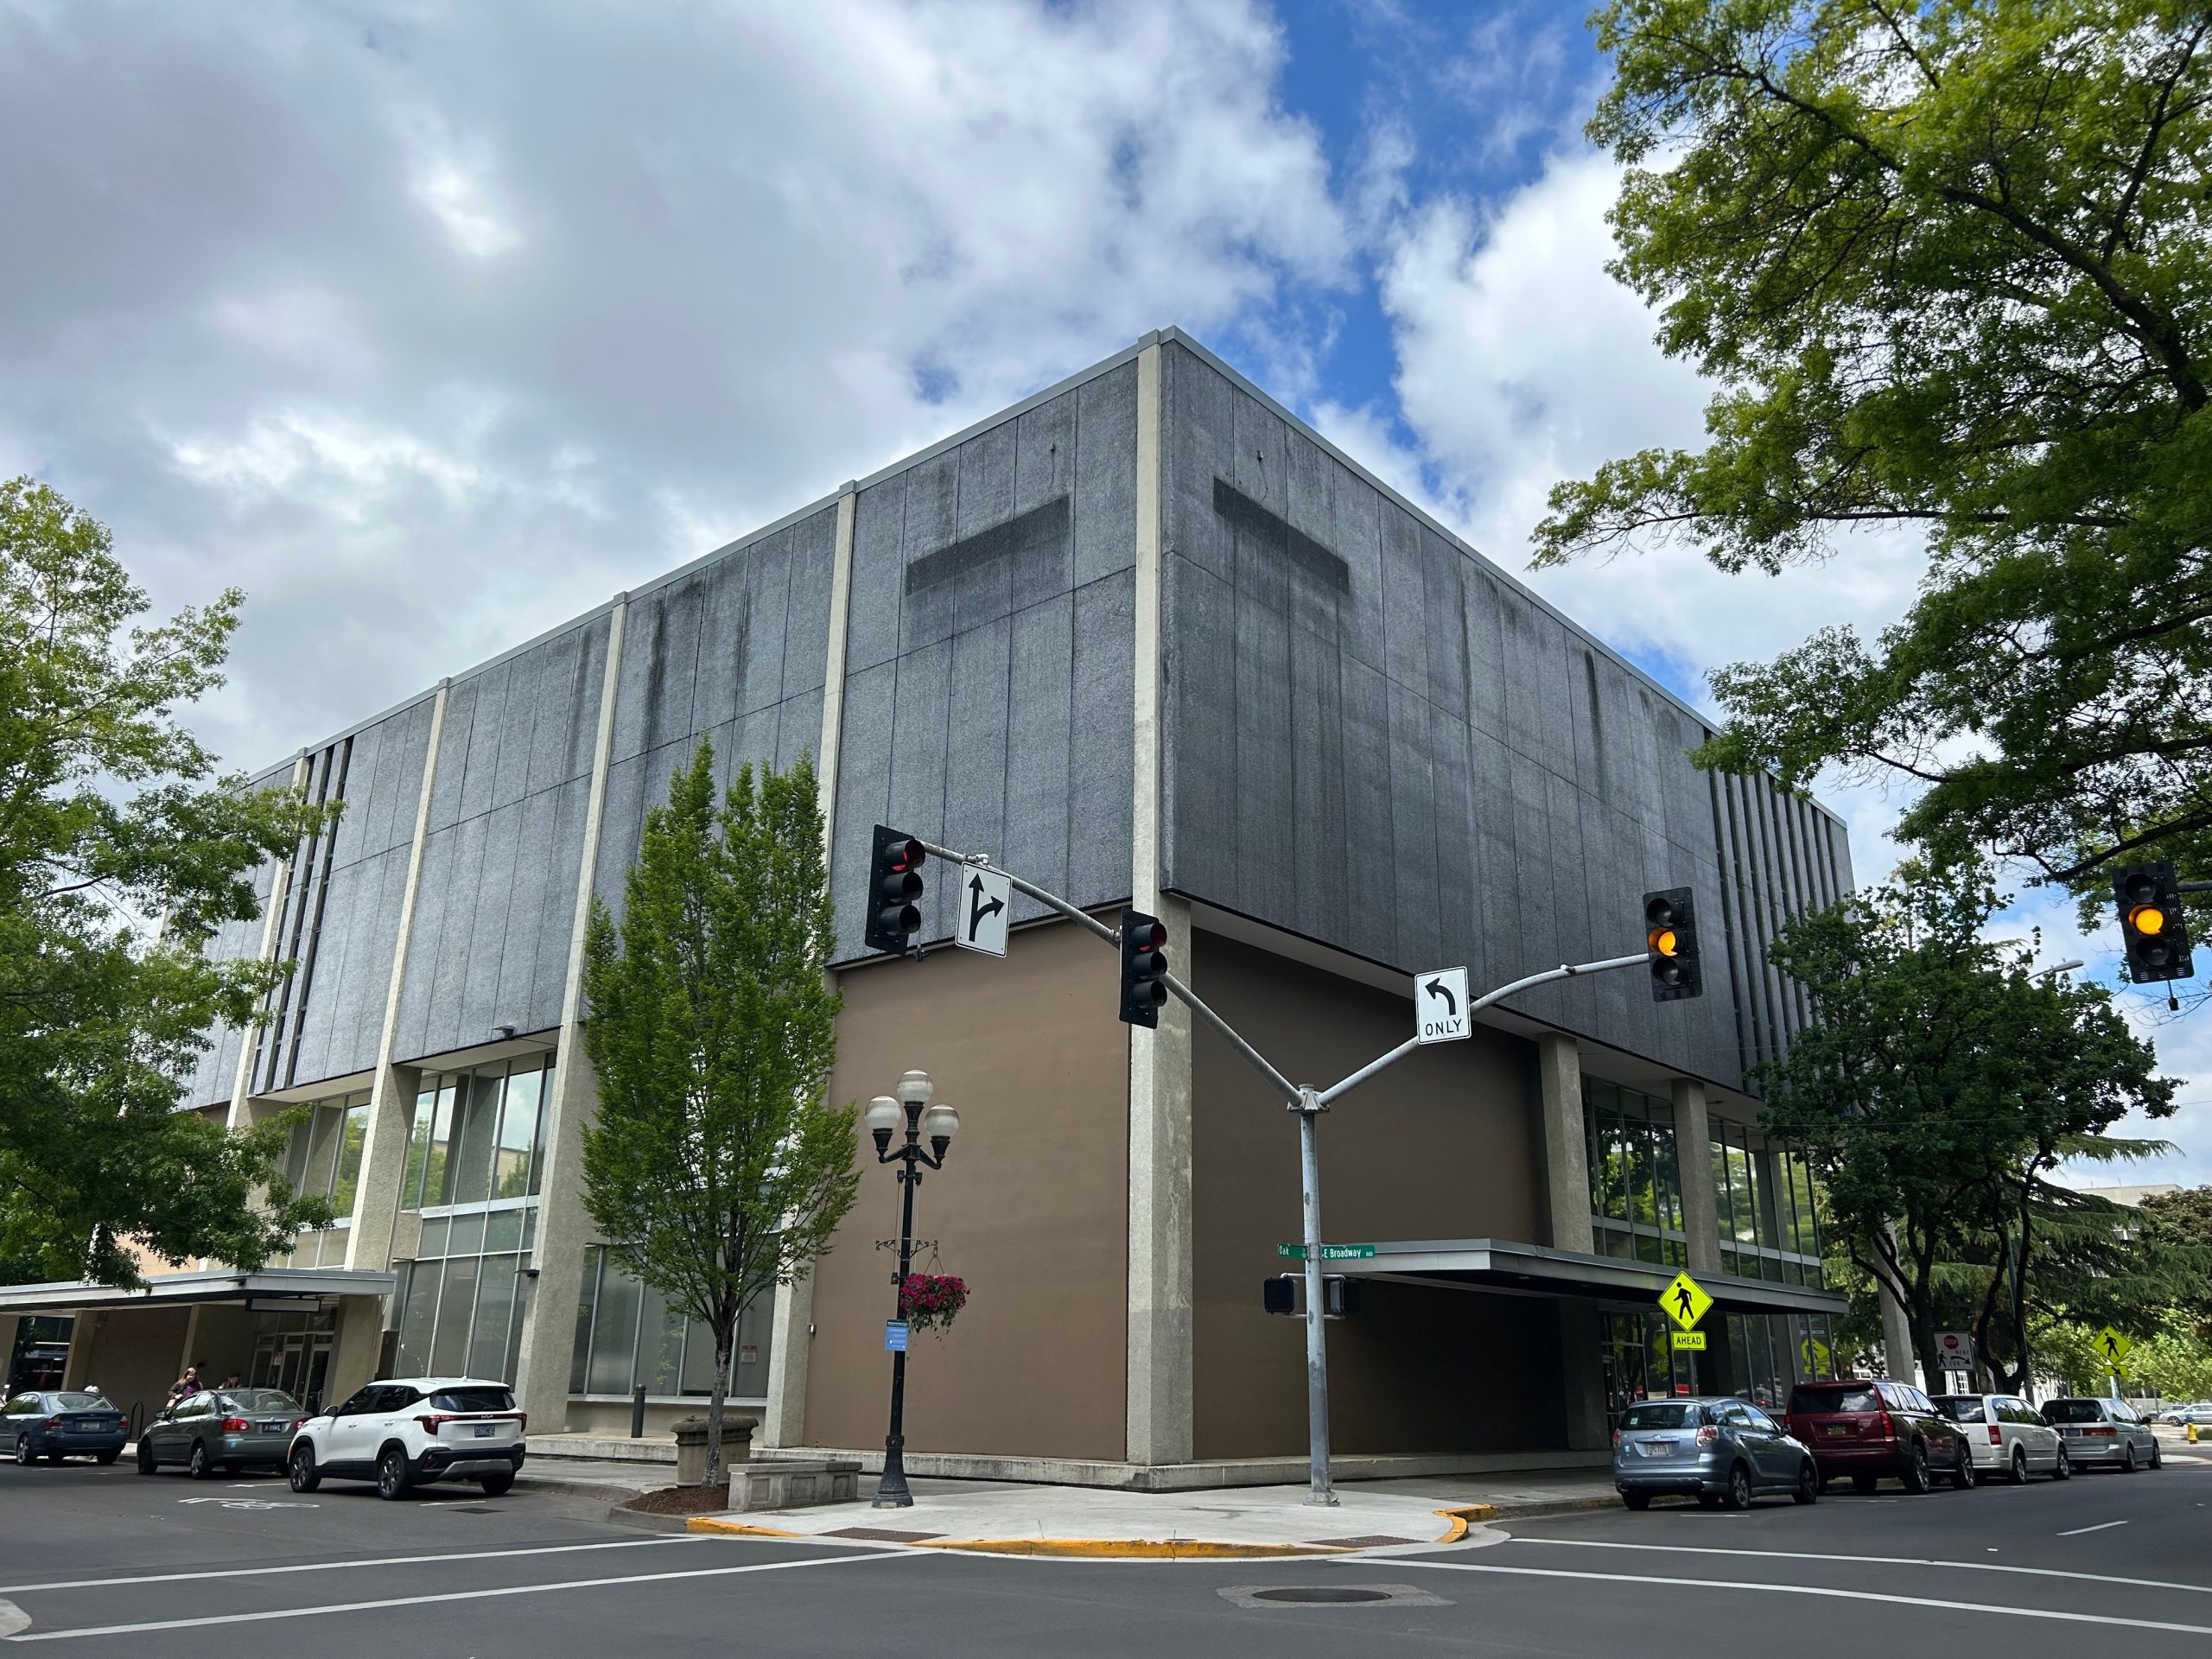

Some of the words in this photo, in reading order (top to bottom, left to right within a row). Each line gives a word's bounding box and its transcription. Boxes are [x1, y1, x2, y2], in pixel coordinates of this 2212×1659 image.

[1425, 1019, 1462, 1036] ONLY
[1279, 1247, 1289, 1255] Oak
[1324, 1249, 1328, 1258] E
[1331, 1248, 1362, 1259] Broadway
[1676, 1336, 1701, 1344] AHEAD
